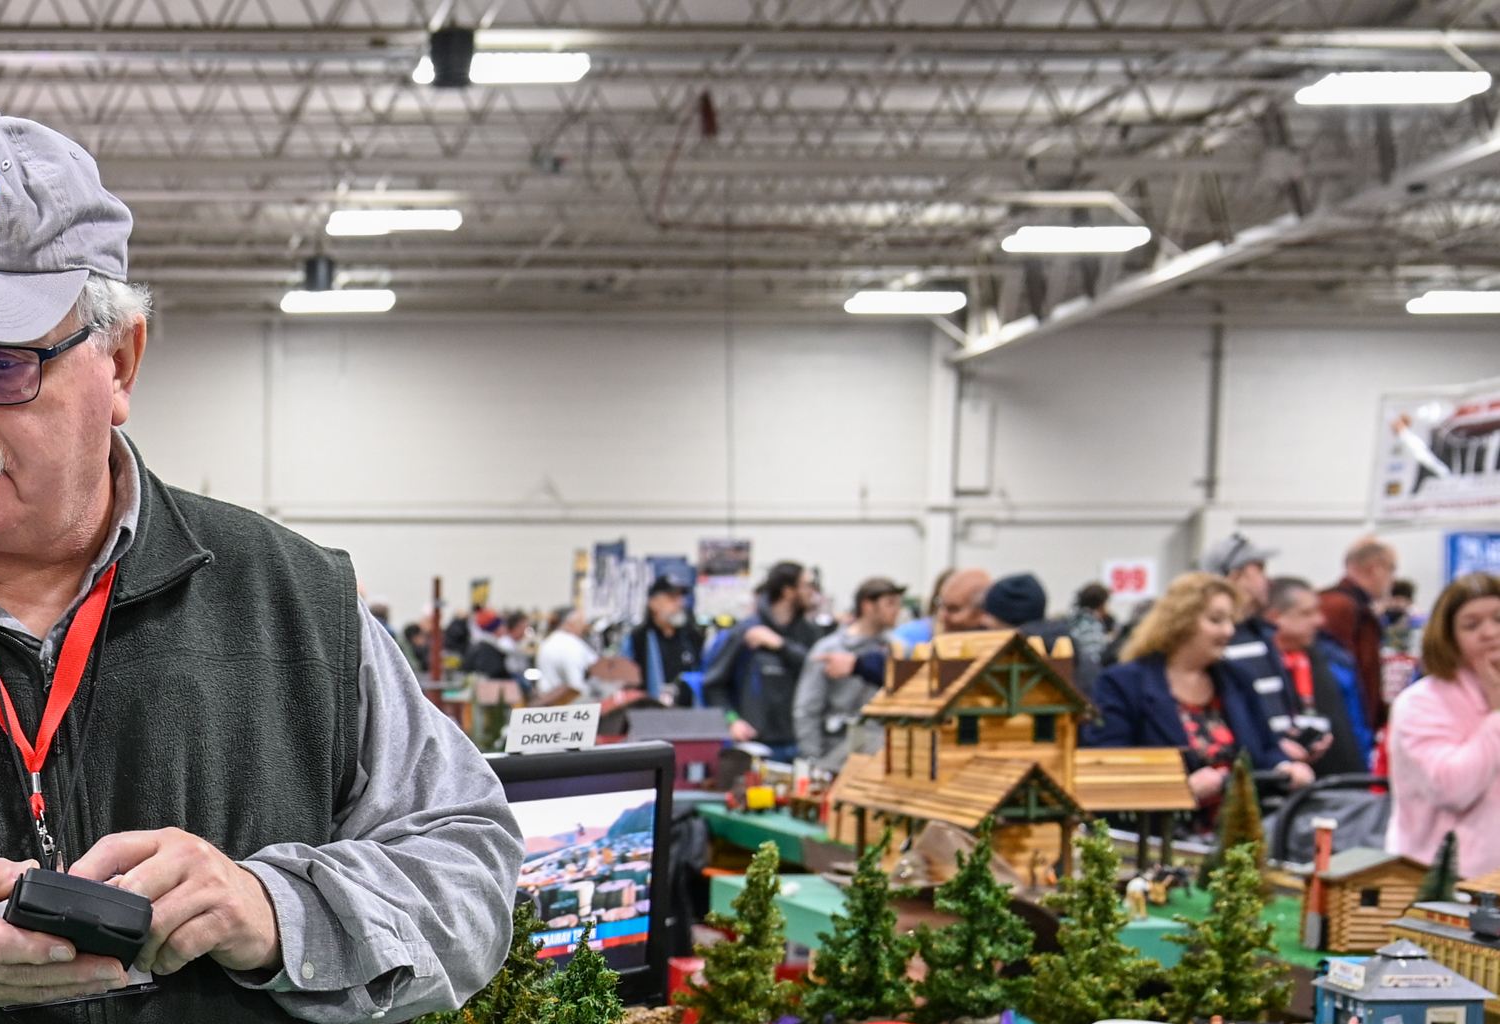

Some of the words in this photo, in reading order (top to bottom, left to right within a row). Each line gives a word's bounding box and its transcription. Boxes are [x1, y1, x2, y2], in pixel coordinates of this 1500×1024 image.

[522, 711, 568, 724] ROUTE
[573, 710, 590, 721] 46
[521, 731, 584, 745] DRIVE-IN
